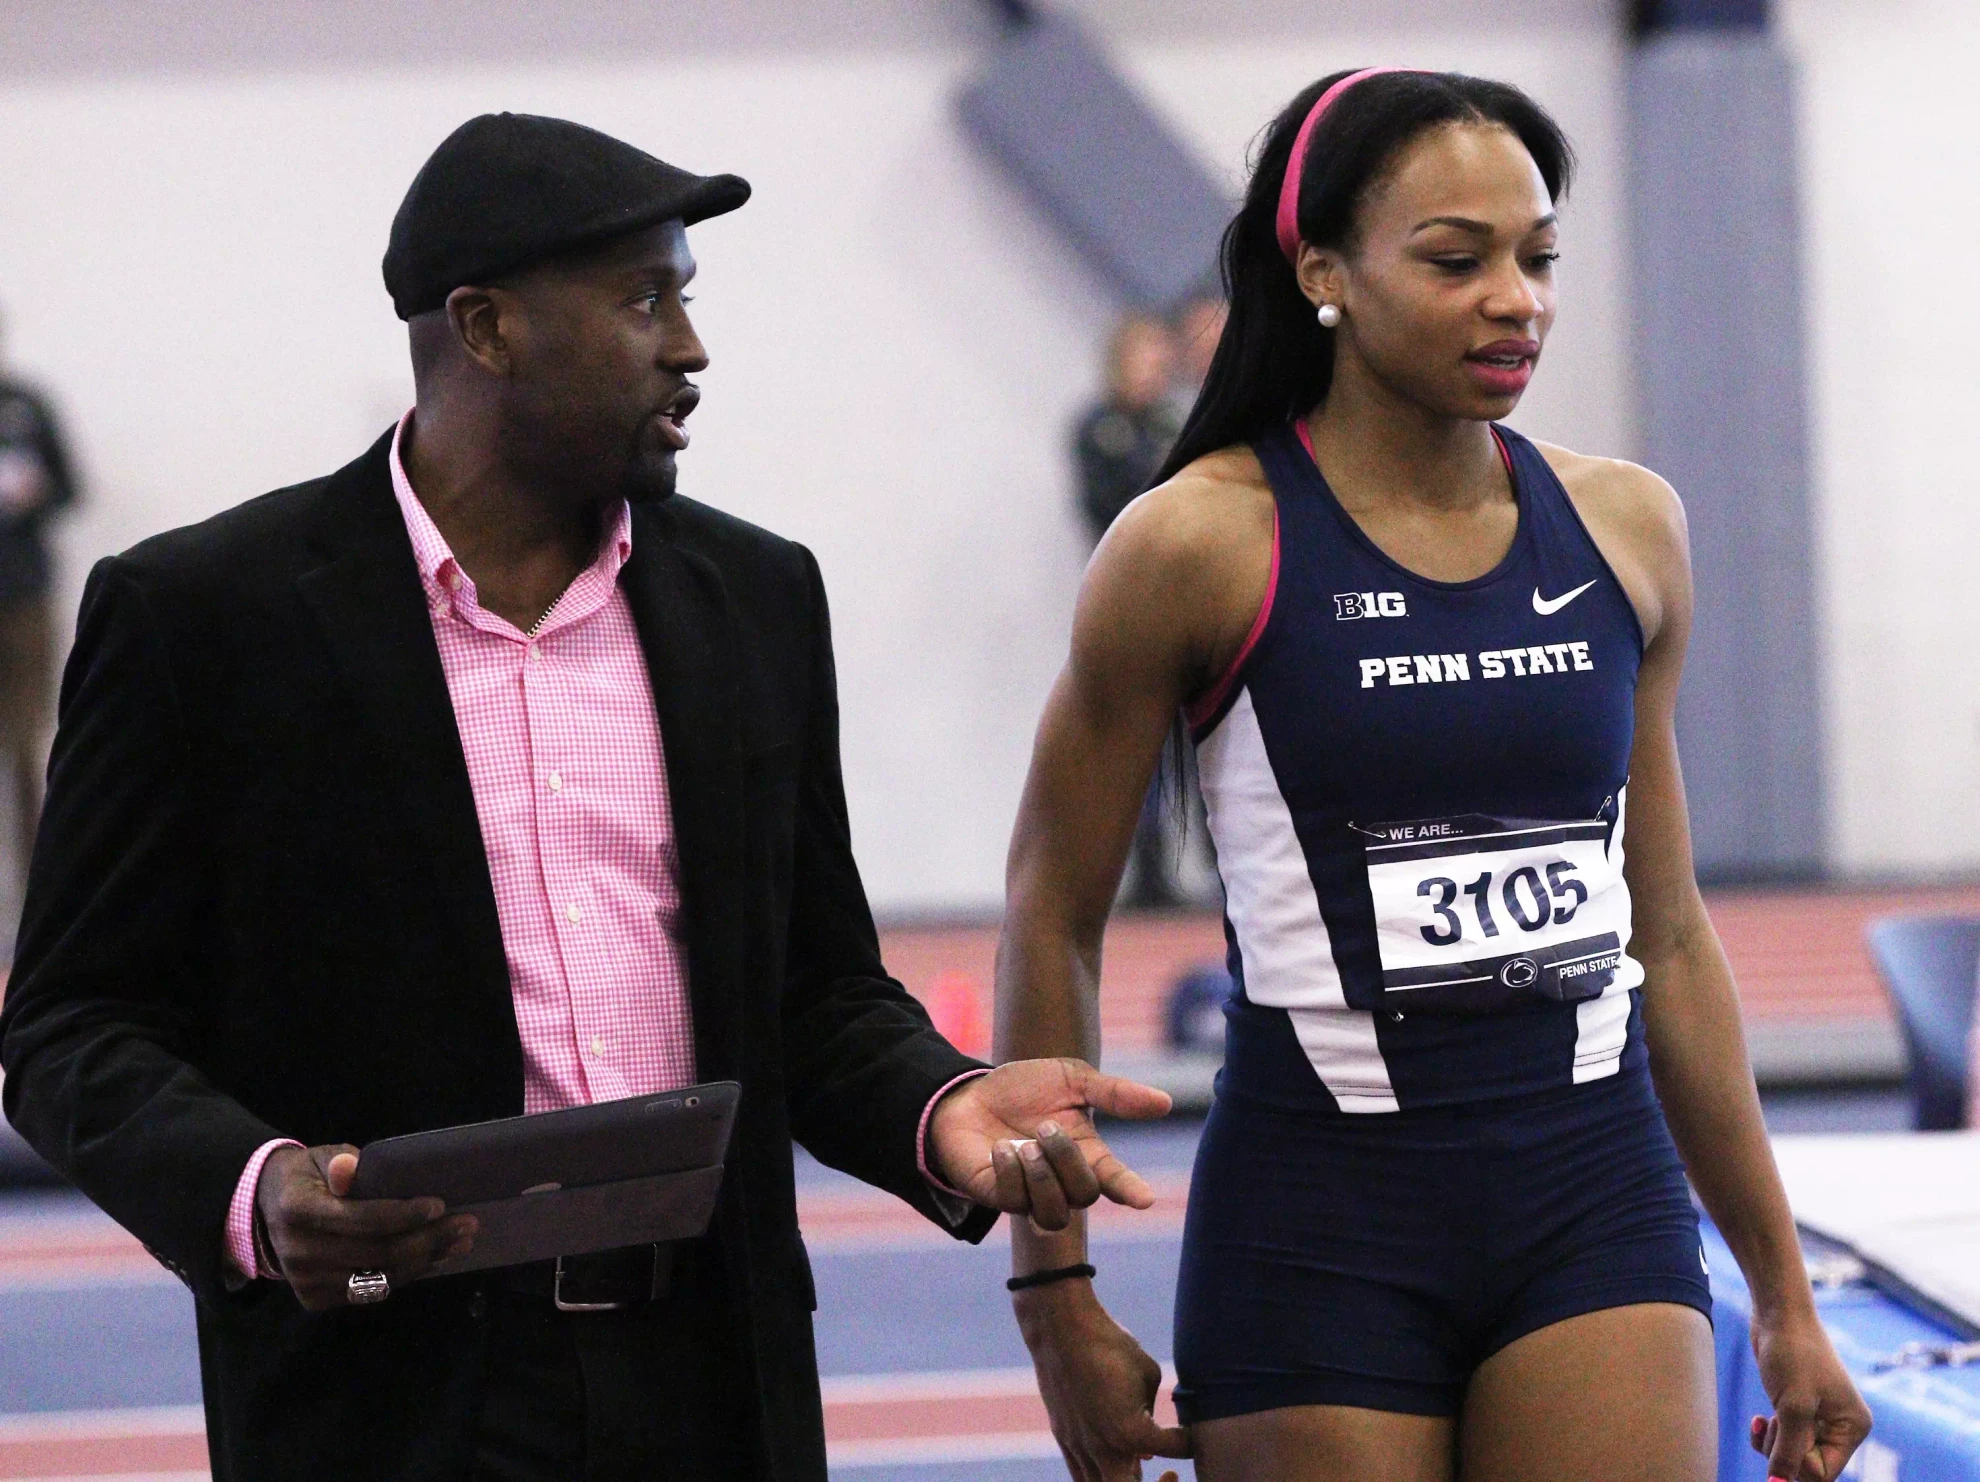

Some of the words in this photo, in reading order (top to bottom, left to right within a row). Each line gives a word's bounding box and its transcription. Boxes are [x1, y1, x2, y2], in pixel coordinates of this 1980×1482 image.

[1359, 653, 1471, 689] PENN
[1478, 641, 1595, 680] STATE
[1388, 826, 1415, 841] WE
[1416, 860, 1588, 946] 3105
[1559, 962, 1588, 979] PENN
